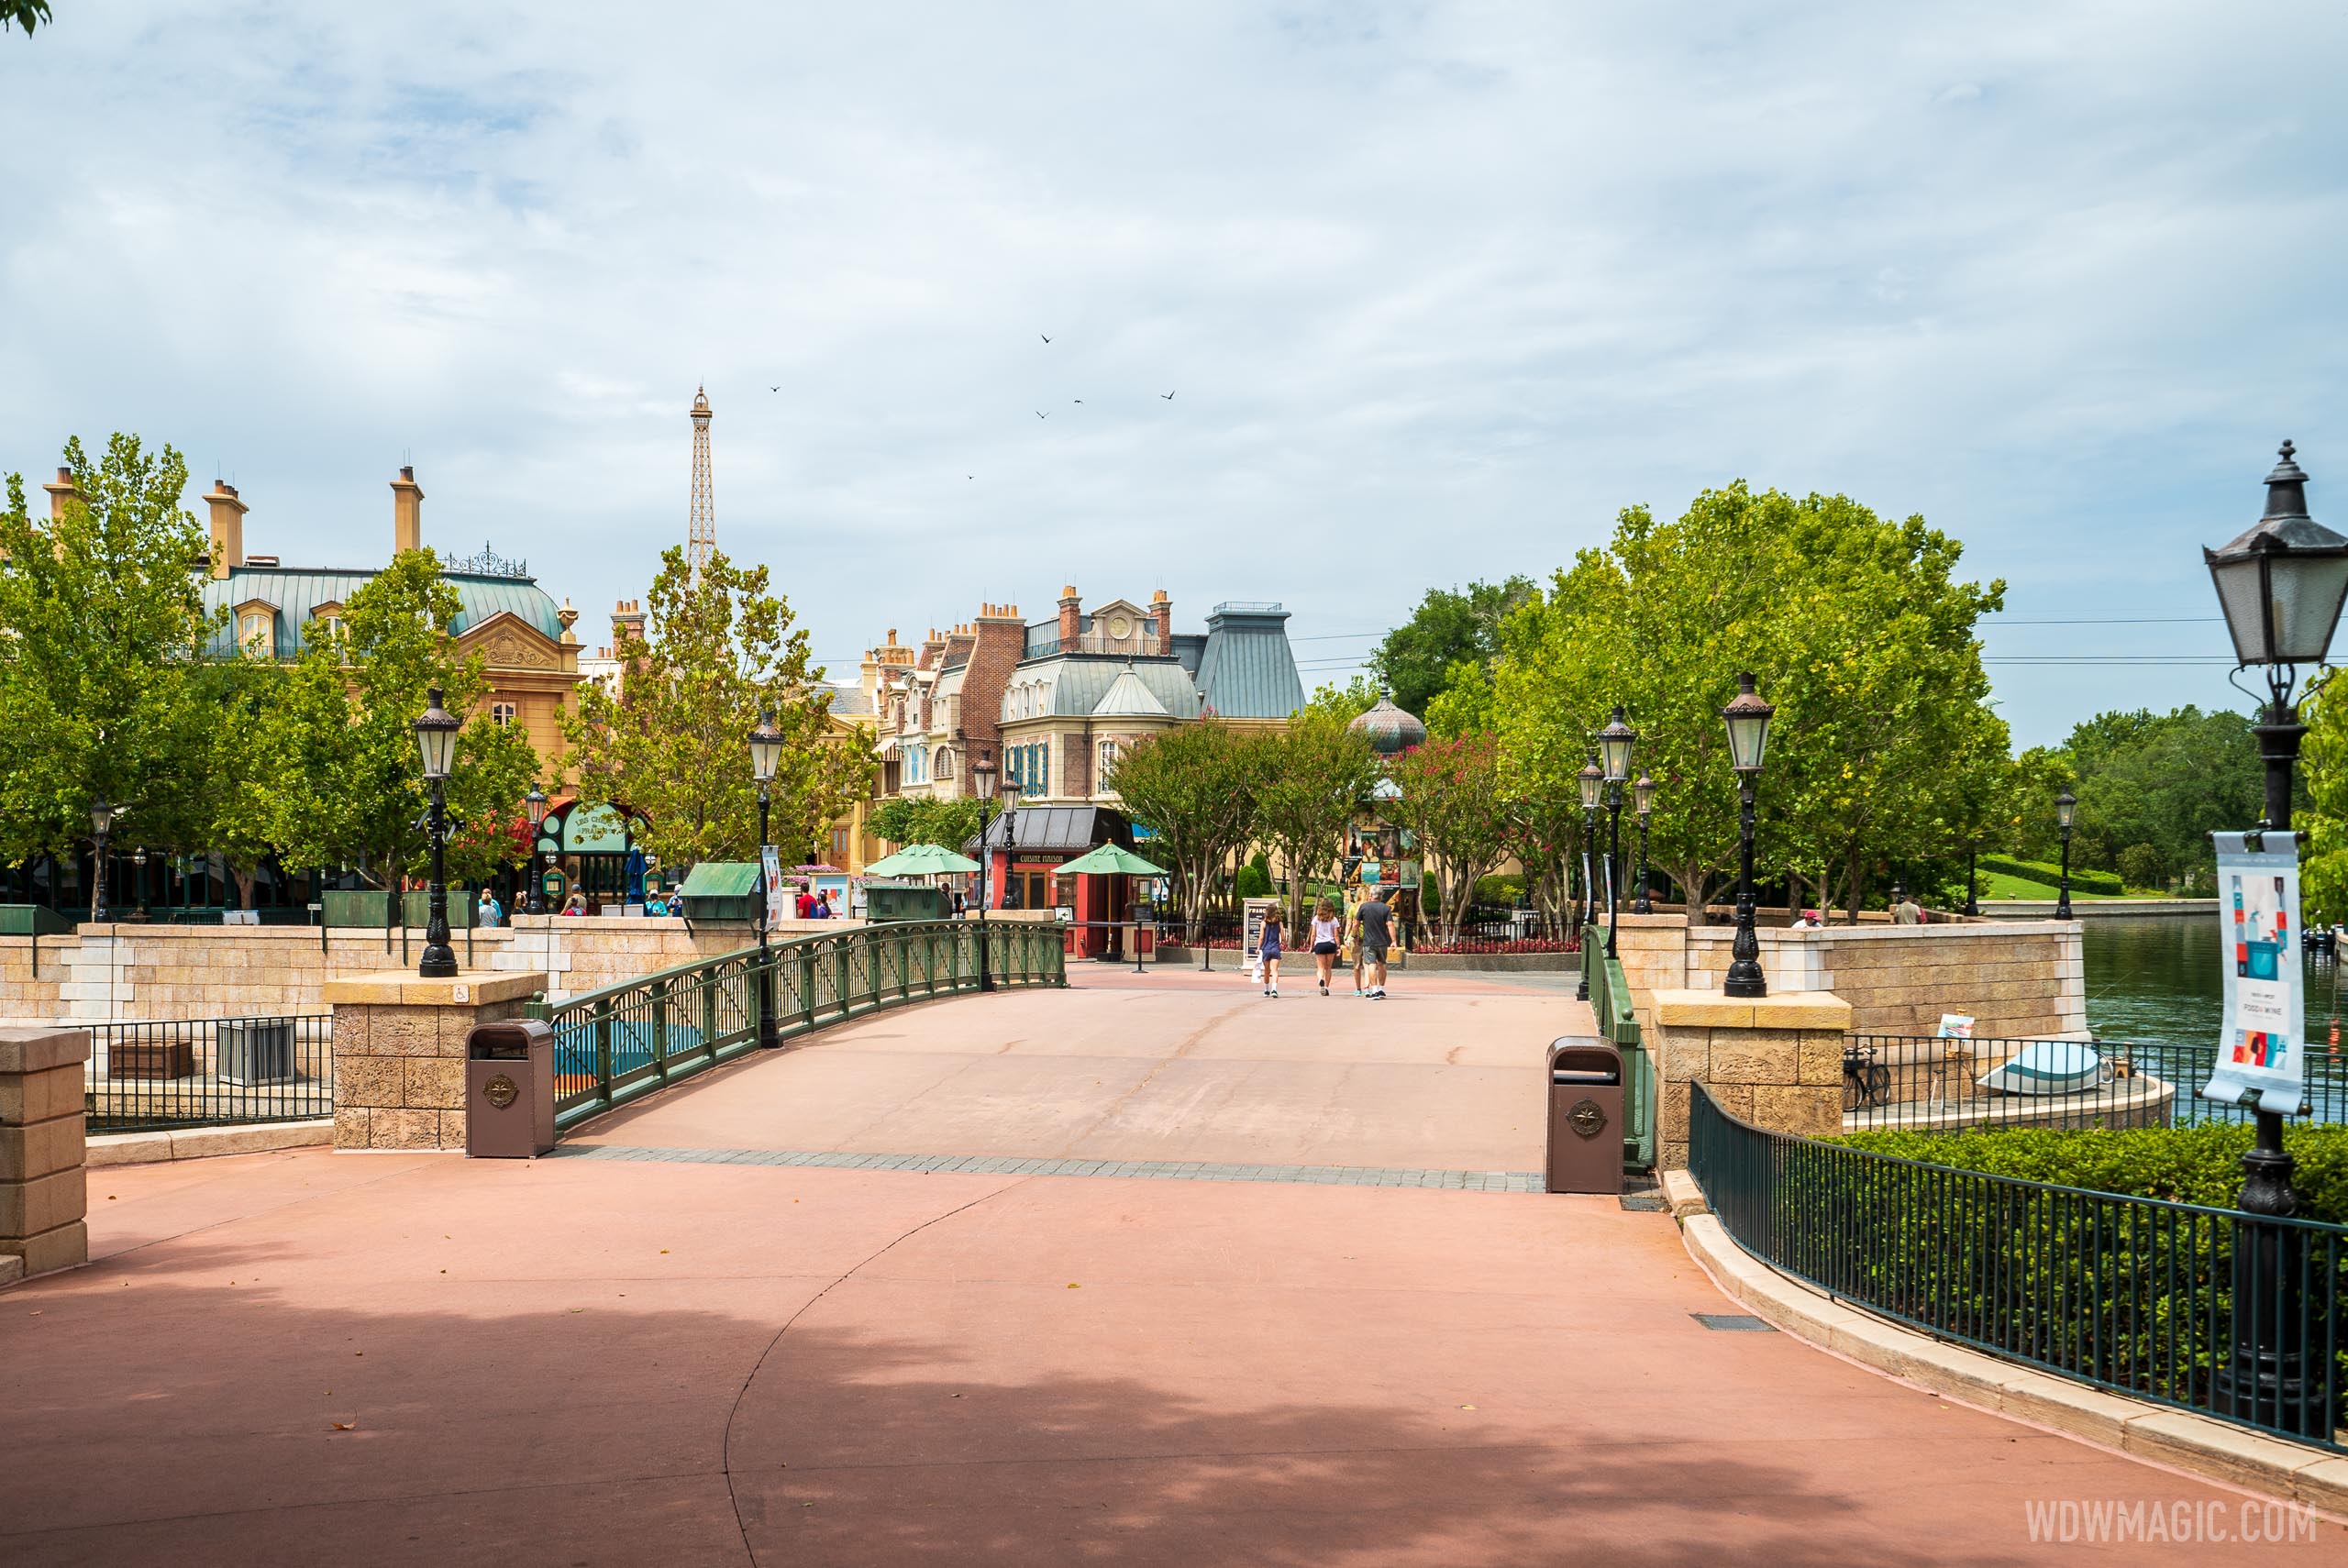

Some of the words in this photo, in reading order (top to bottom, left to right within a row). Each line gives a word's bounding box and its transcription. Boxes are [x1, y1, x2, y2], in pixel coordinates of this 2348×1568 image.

[575, 816, 589, 826] LES
[1020, 855, 1040, 863] CUISINE
[1042, 855, 1064, 863] MAISON
